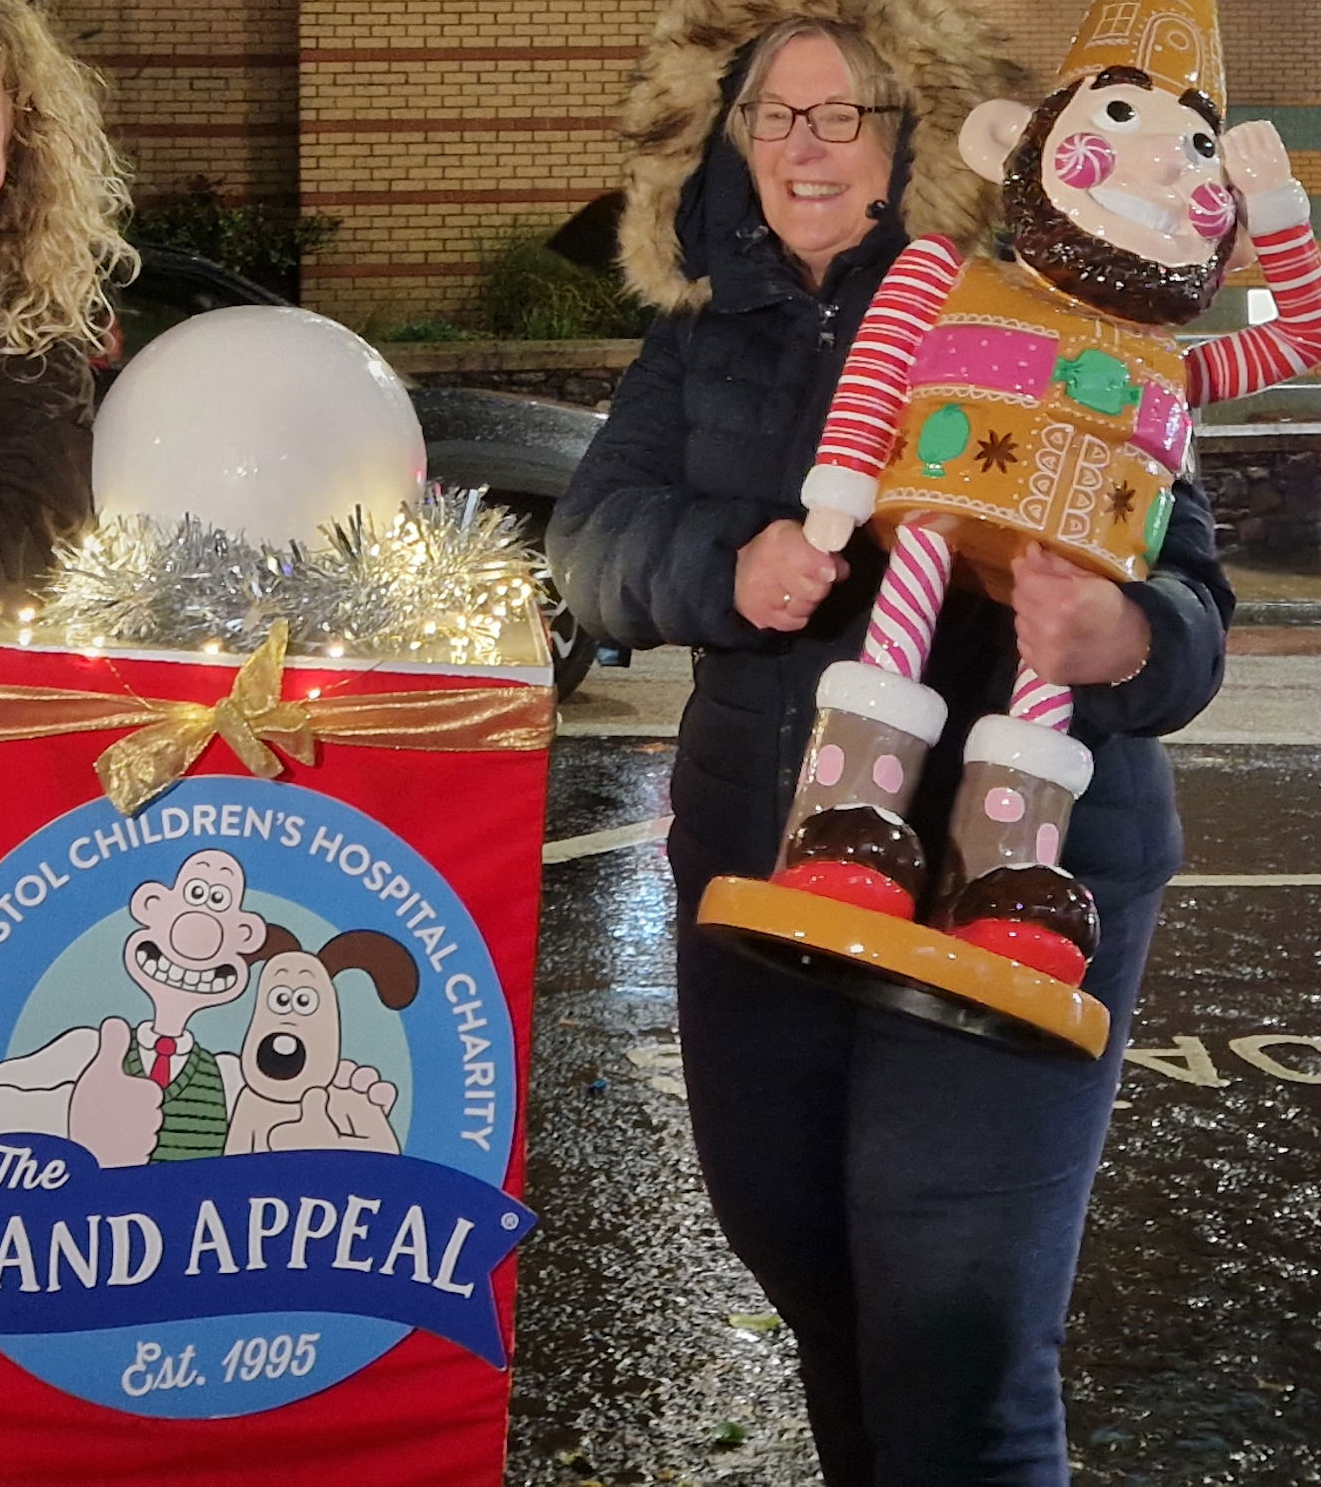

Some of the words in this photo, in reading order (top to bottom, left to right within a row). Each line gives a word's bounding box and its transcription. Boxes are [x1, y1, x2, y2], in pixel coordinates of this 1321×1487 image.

[69, 804, 305, 870] CHILDREN'S
[309, 825, 458, 973] HOSPITAL
[445, 973, 496, 1152] CHARITY
[184, 1194, 475, 1299] APPEAL
[121, 1341, 206, 1397] Est.
[222, 1332, 321, 1384] 1995
